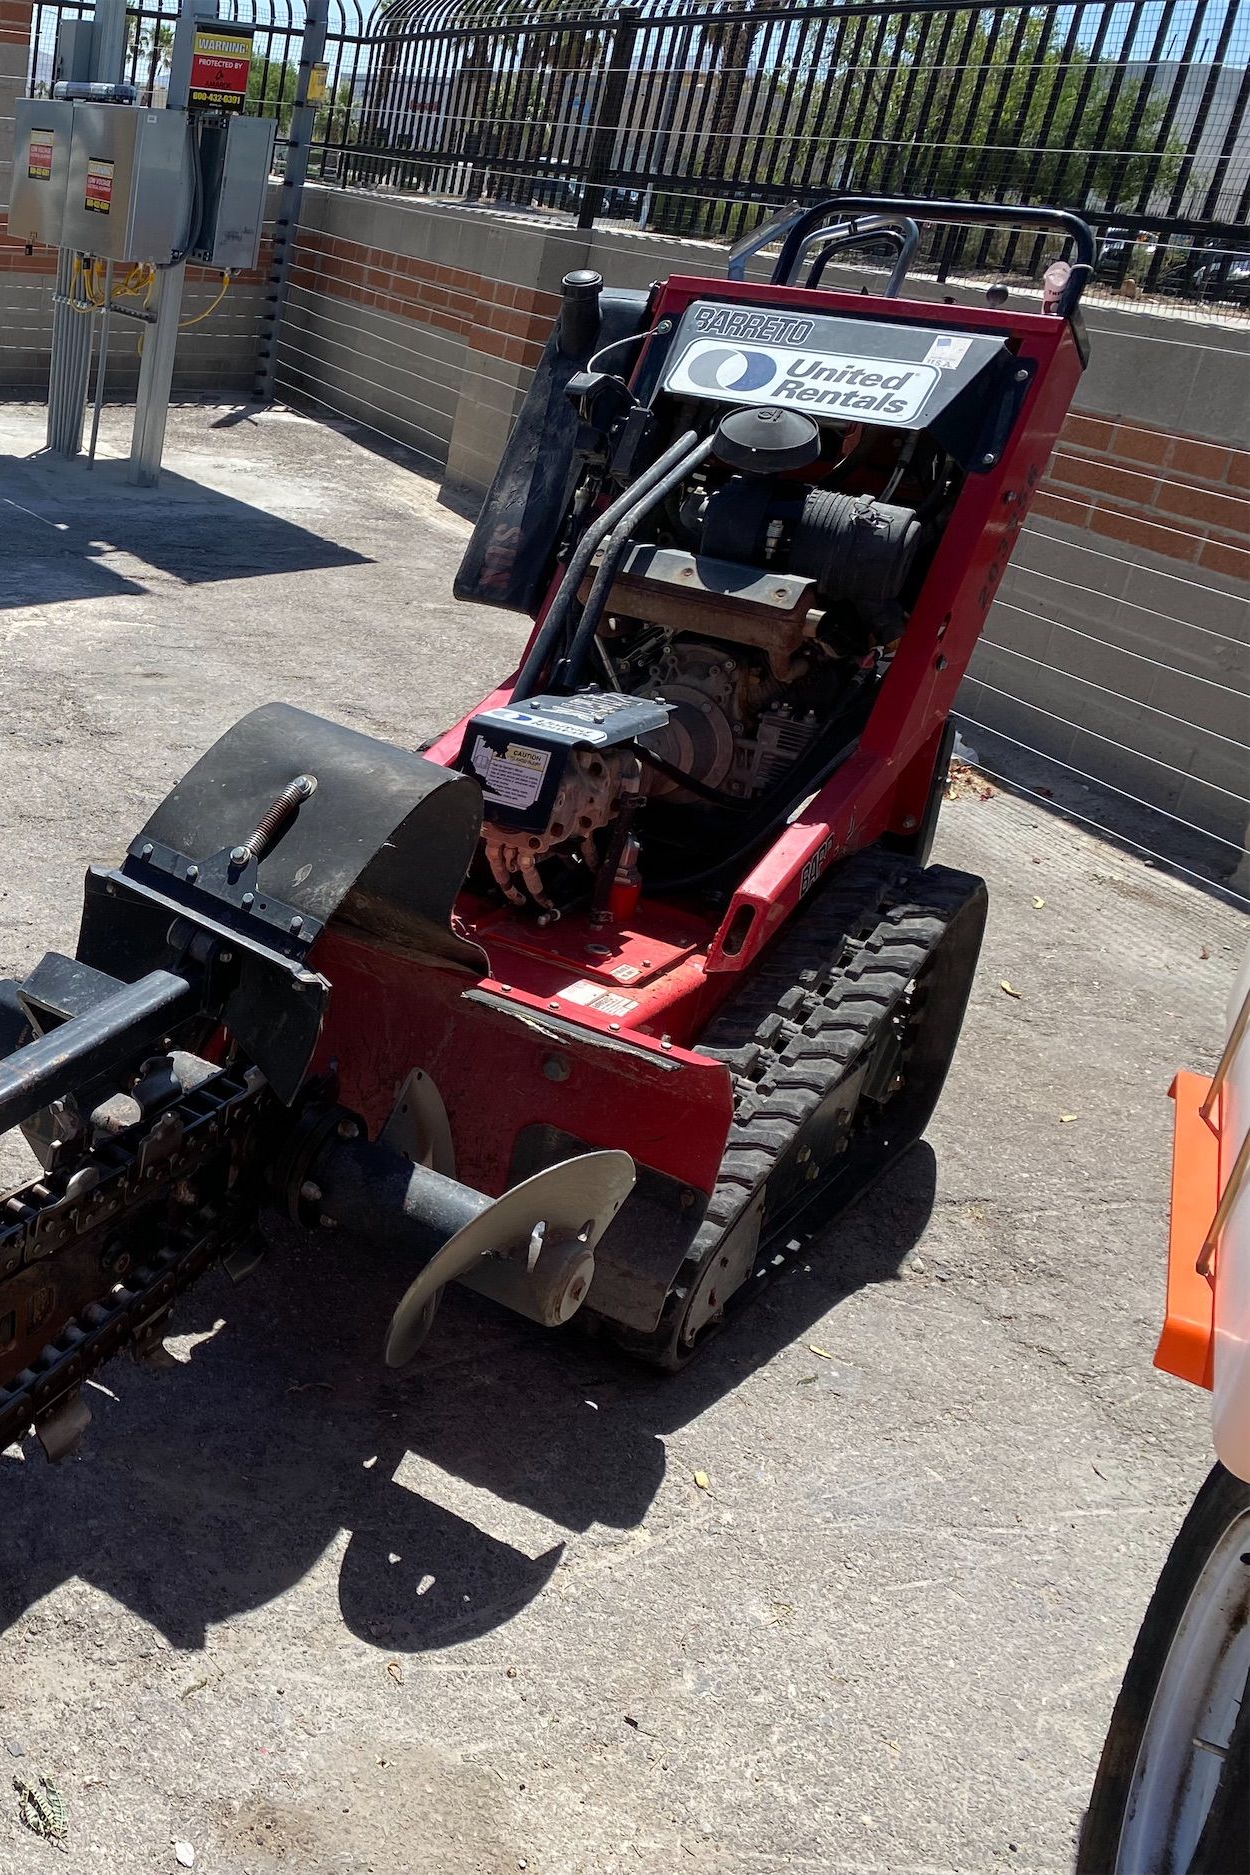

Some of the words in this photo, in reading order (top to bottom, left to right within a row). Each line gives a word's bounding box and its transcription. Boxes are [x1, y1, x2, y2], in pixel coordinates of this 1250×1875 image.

[198, 38, 249, 54] WARNING!
[198, 58, 234, 69] PROTECTED
[694, 306, 815, 345] BARRETO
[786, 358, 915, 390] United
[770, 379, 908, 413] Rentals
[513, 750, 542, 762] CAUTION
